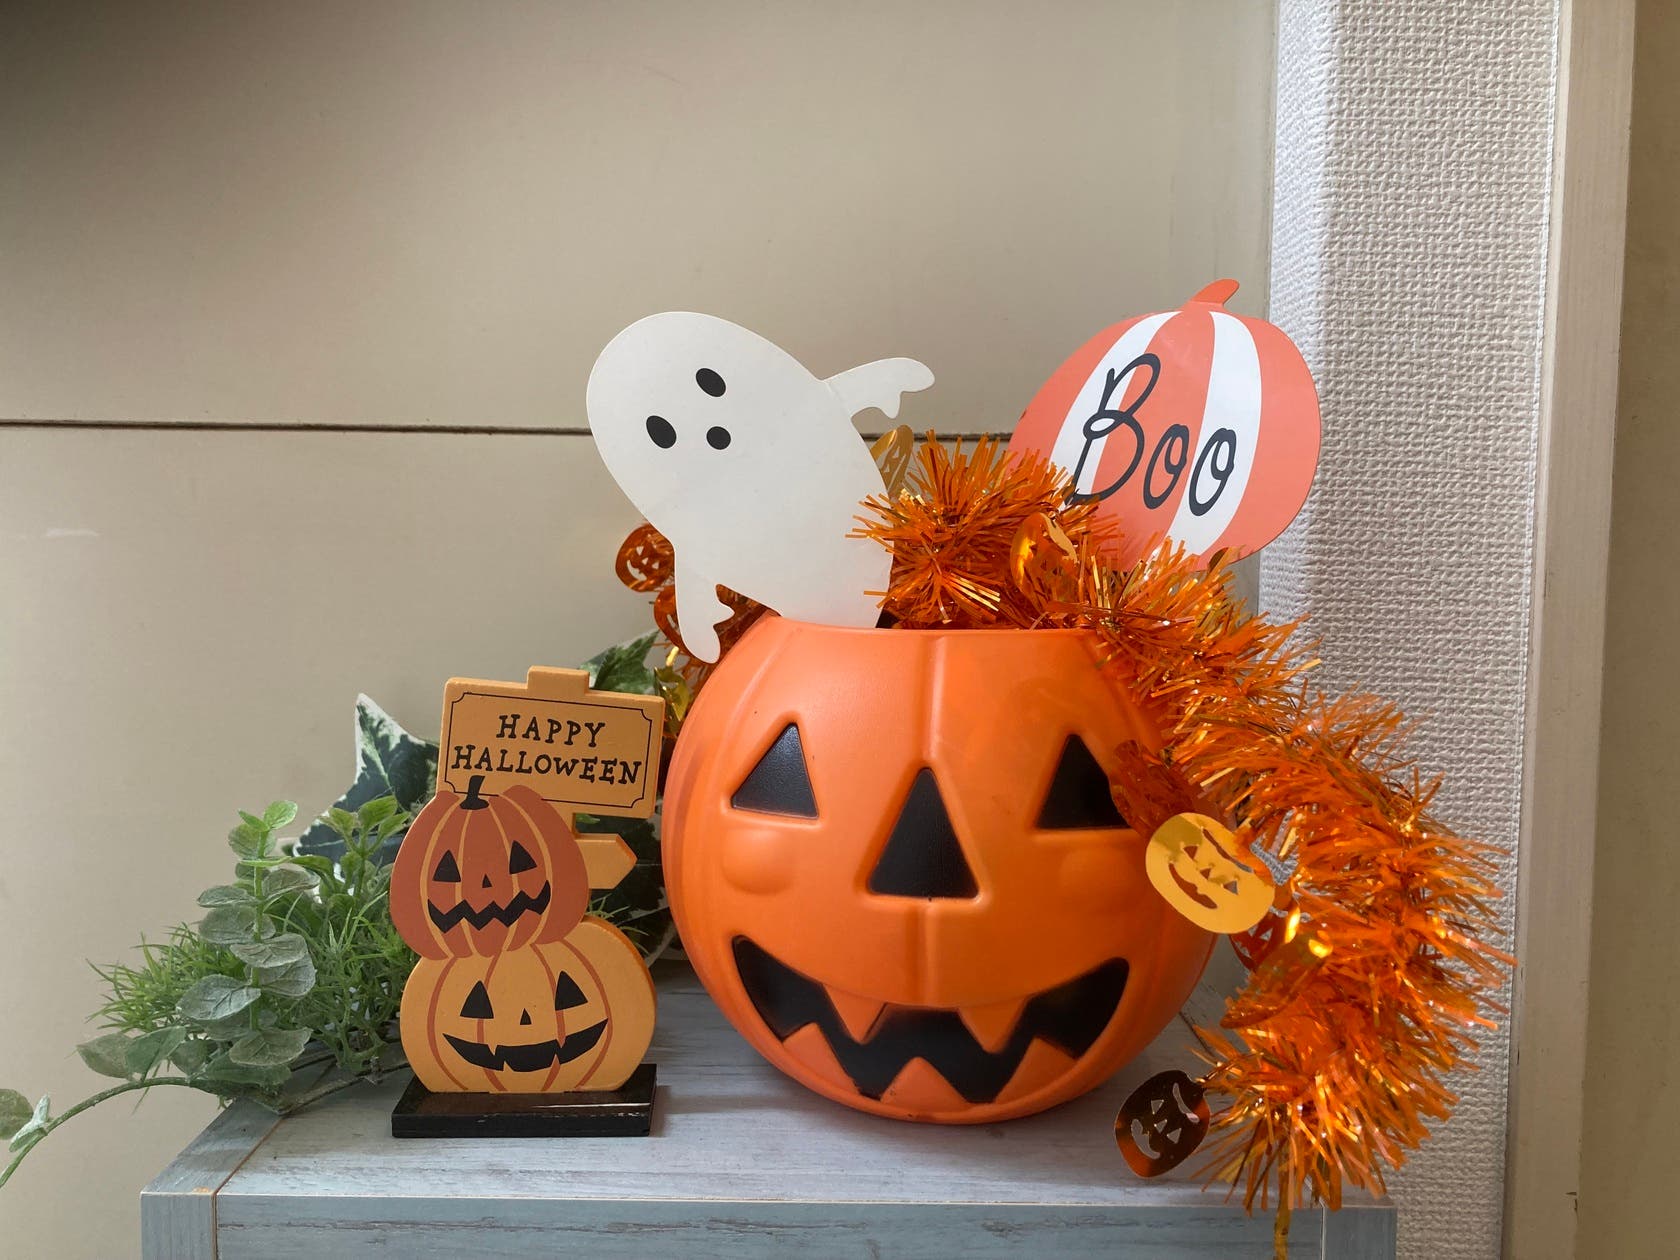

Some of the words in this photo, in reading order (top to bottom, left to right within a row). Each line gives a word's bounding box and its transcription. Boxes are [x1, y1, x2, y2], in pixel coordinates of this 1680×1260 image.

[1063, 353, 1237, 517] Boo
[496, 714, 606, 747] HAPPY
[451, 744, 642, 785] HALLOWEEN
